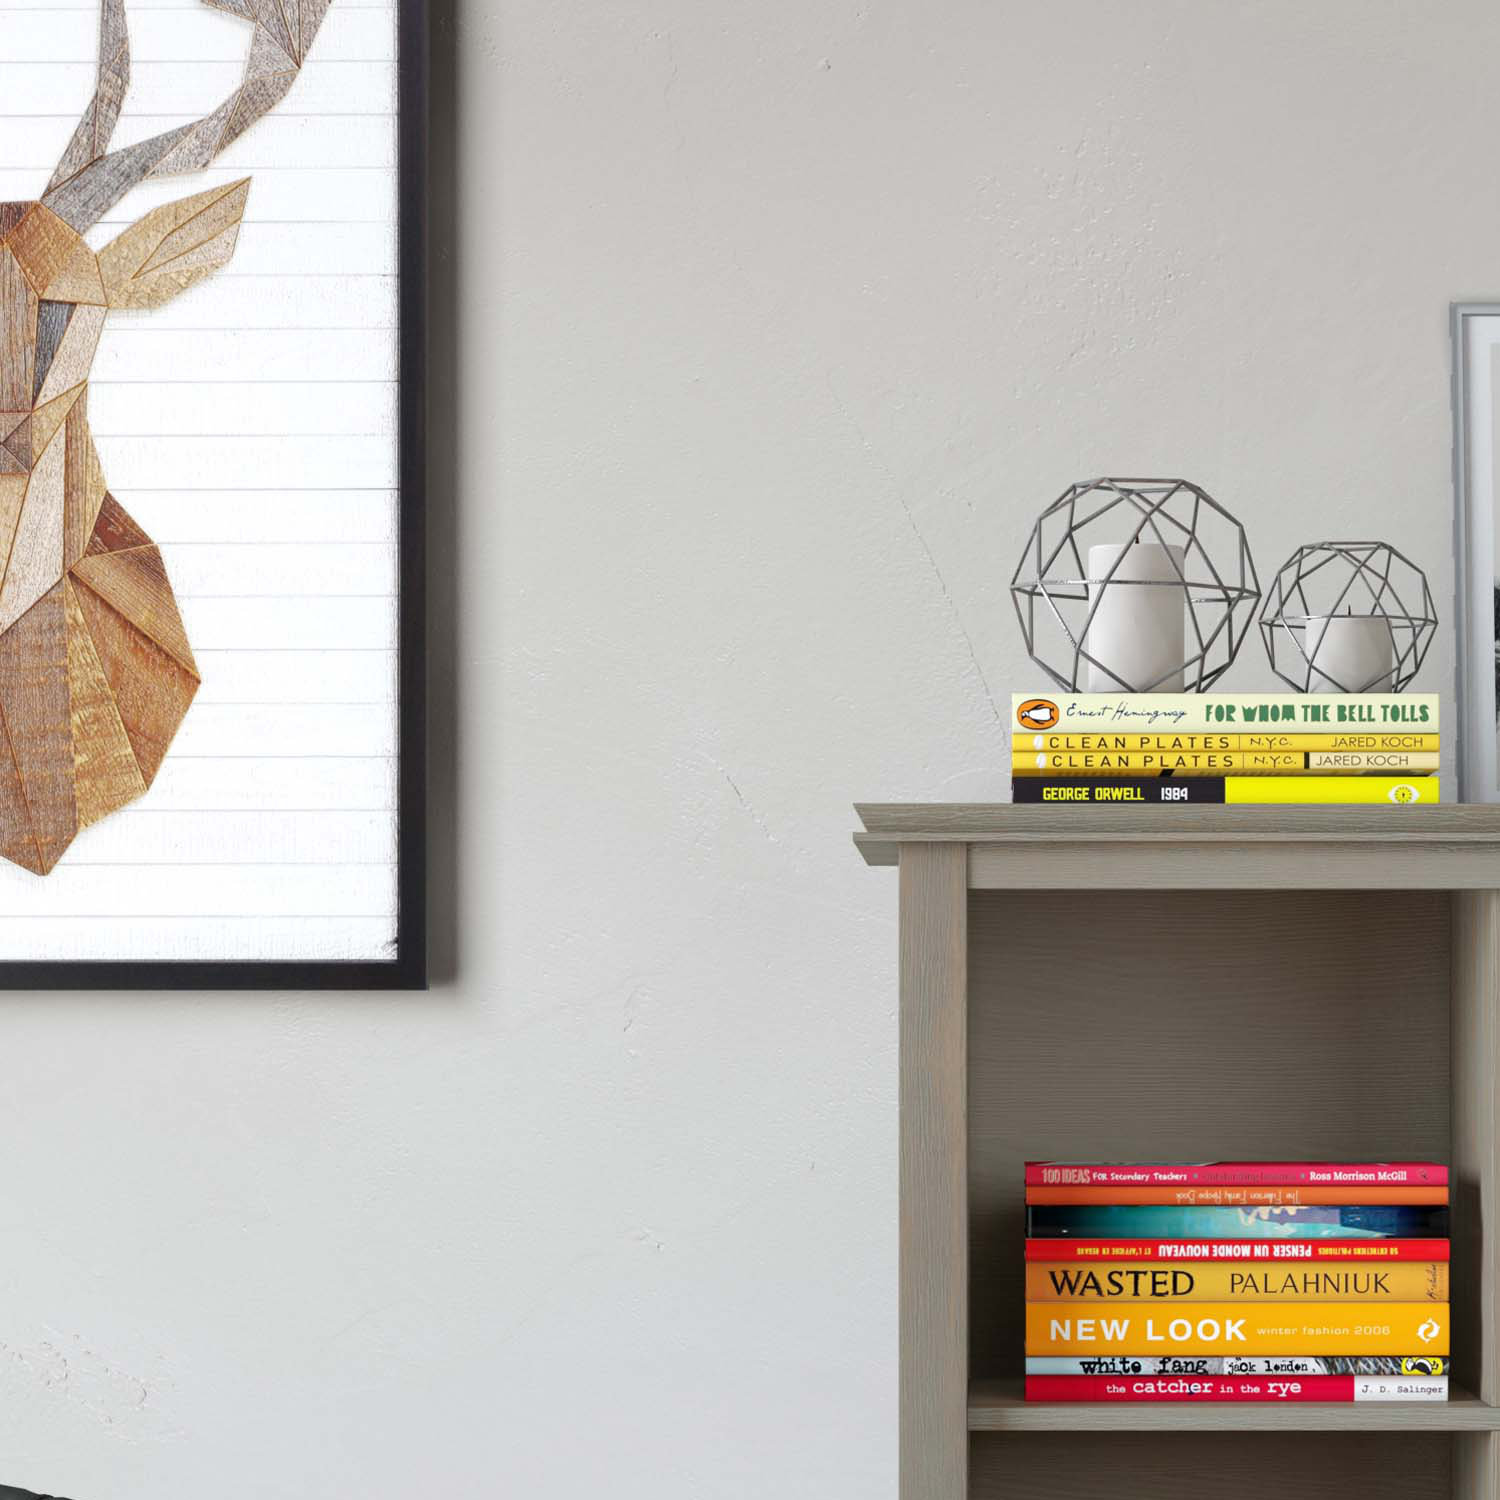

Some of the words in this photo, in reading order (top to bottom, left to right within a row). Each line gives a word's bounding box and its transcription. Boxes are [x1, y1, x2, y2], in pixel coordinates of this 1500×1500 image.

[1066, 702, 1113, 717] Ernest
[1111, 701, 1188, 723] Hemingway
[1205, 704, 1236, 722] FOR
[1242, 704, 1296, 722] WHOM
[1301, 704, 1330, 722] THE
[1337, 704, 1375, 722] BELL
[1380, 704, 1429, 722] TOLLS
[1049, 736, 1126, 748] CLEAN
[1139, 736, 1229, 748] PLATES
[1249, 737, 1292, 749] N.Y.C.
[1331, 736, 1377, 748] JARED
[1381, 736, 1423, 748] KOCH
[1051, 755, 1129, 767] CLEAN
[1143, 755, 1233, 767] PLATES
[1253, 756, 1297, 768] N.Y.C.
[1315, 755, 1362, 766] JARED
[1366, 755, 1409, 766] KOCH
[1042, 787, 1090, 801] GEORGE
[1094, 787, 1145, 801] ORWELL
[1160, 787, 1188, 801] 1984
[1042, 1168, 1061, 1184] 100
[1061, 1168, 1091, 1184] IDEAS
[1092, 1172, 1108, 1180] FOR
[1110, 1172, 1150, 1182] Secondary
[1153, 1172, 1187, 1180] Teachers
[1309, 1171, 1331, 1181] Ross
[1333, 1171, 1376, 1181] Morrison
[1377, 1171, 1407, 1181] McGill
[1158, 1244, 1209, 1257] NOUVEAU
[1213, 1244, 1251, 1257] MONDE
[1254, 1244, 1270, 1257] UN
[1274, 1244, 1312, 1257] PENSER
[1048, 1269, 1195, 1297] WASTED
[1230, 1272, 1391, 1294] PALAHNIUK
[1050, 1318, 1130, 1341] NEW
[1146, 1318, 1247, 1341] LOOK
[1256, 1326, 1297, 1335] winter
[1302, 1325, 1350, 1335] fashion
[1079, 1357, 1142, 1375] white
[1157, 1357, 1209, 1375] fang
[1264, 1360, 1308, 1372] london
[1106, 1384, 1126, 1393] the
[1132, 1379, 1214, 1394] catcher
[1219, 1384, 1234, 1393] in
[1240, 1384, 1261, 1393] the
[1267, 1381, 1302, 1397] rye
[1361, 1384, 1373, 1393] J.
[1379, 1384, 1391, 1393] D.
[1397, 1384, 1444, 1395] Salinger
